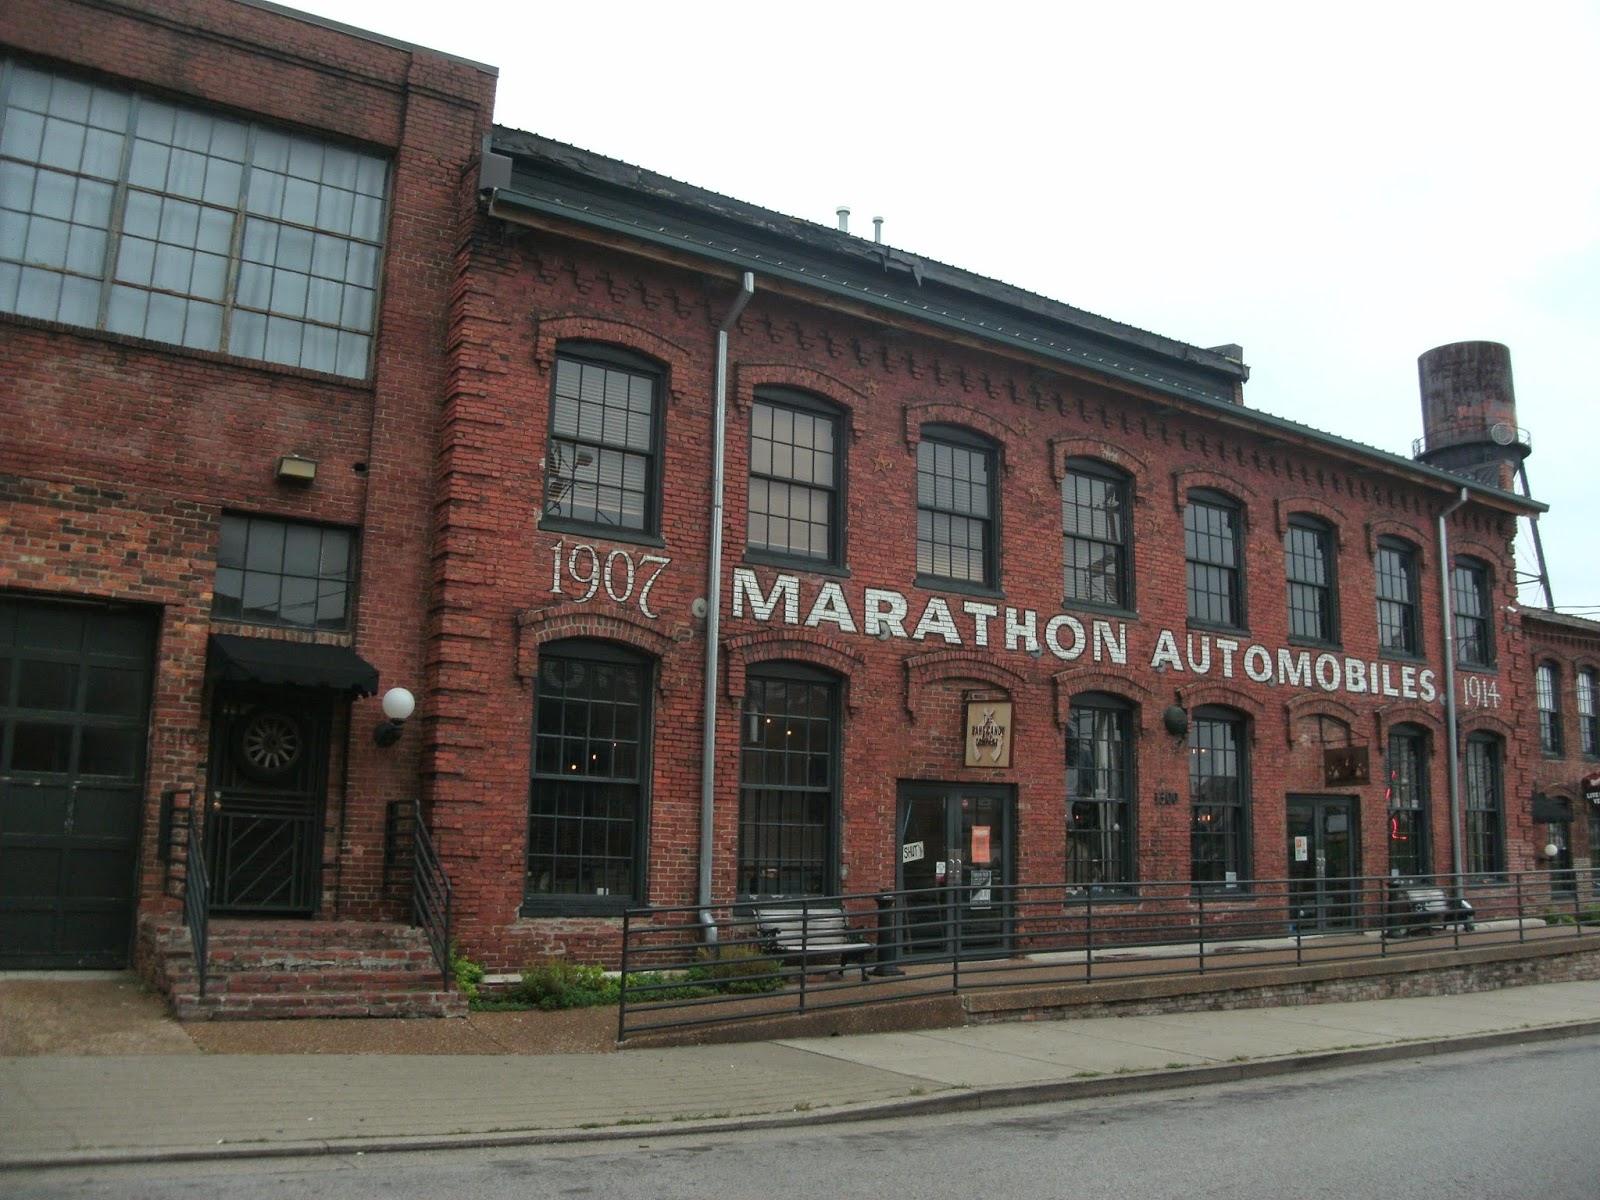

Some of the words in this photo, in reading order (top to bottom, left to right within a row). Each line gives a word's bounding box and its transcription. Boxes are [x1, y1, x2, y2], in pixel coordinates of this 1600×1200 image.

[548, 538, 672, 620] 1907
[732, 566, 1128, 666] MARATHON
[1149, 628, 1437, 703] AUTOMOBILES
[1462, 675, 1503, 711] 1914
